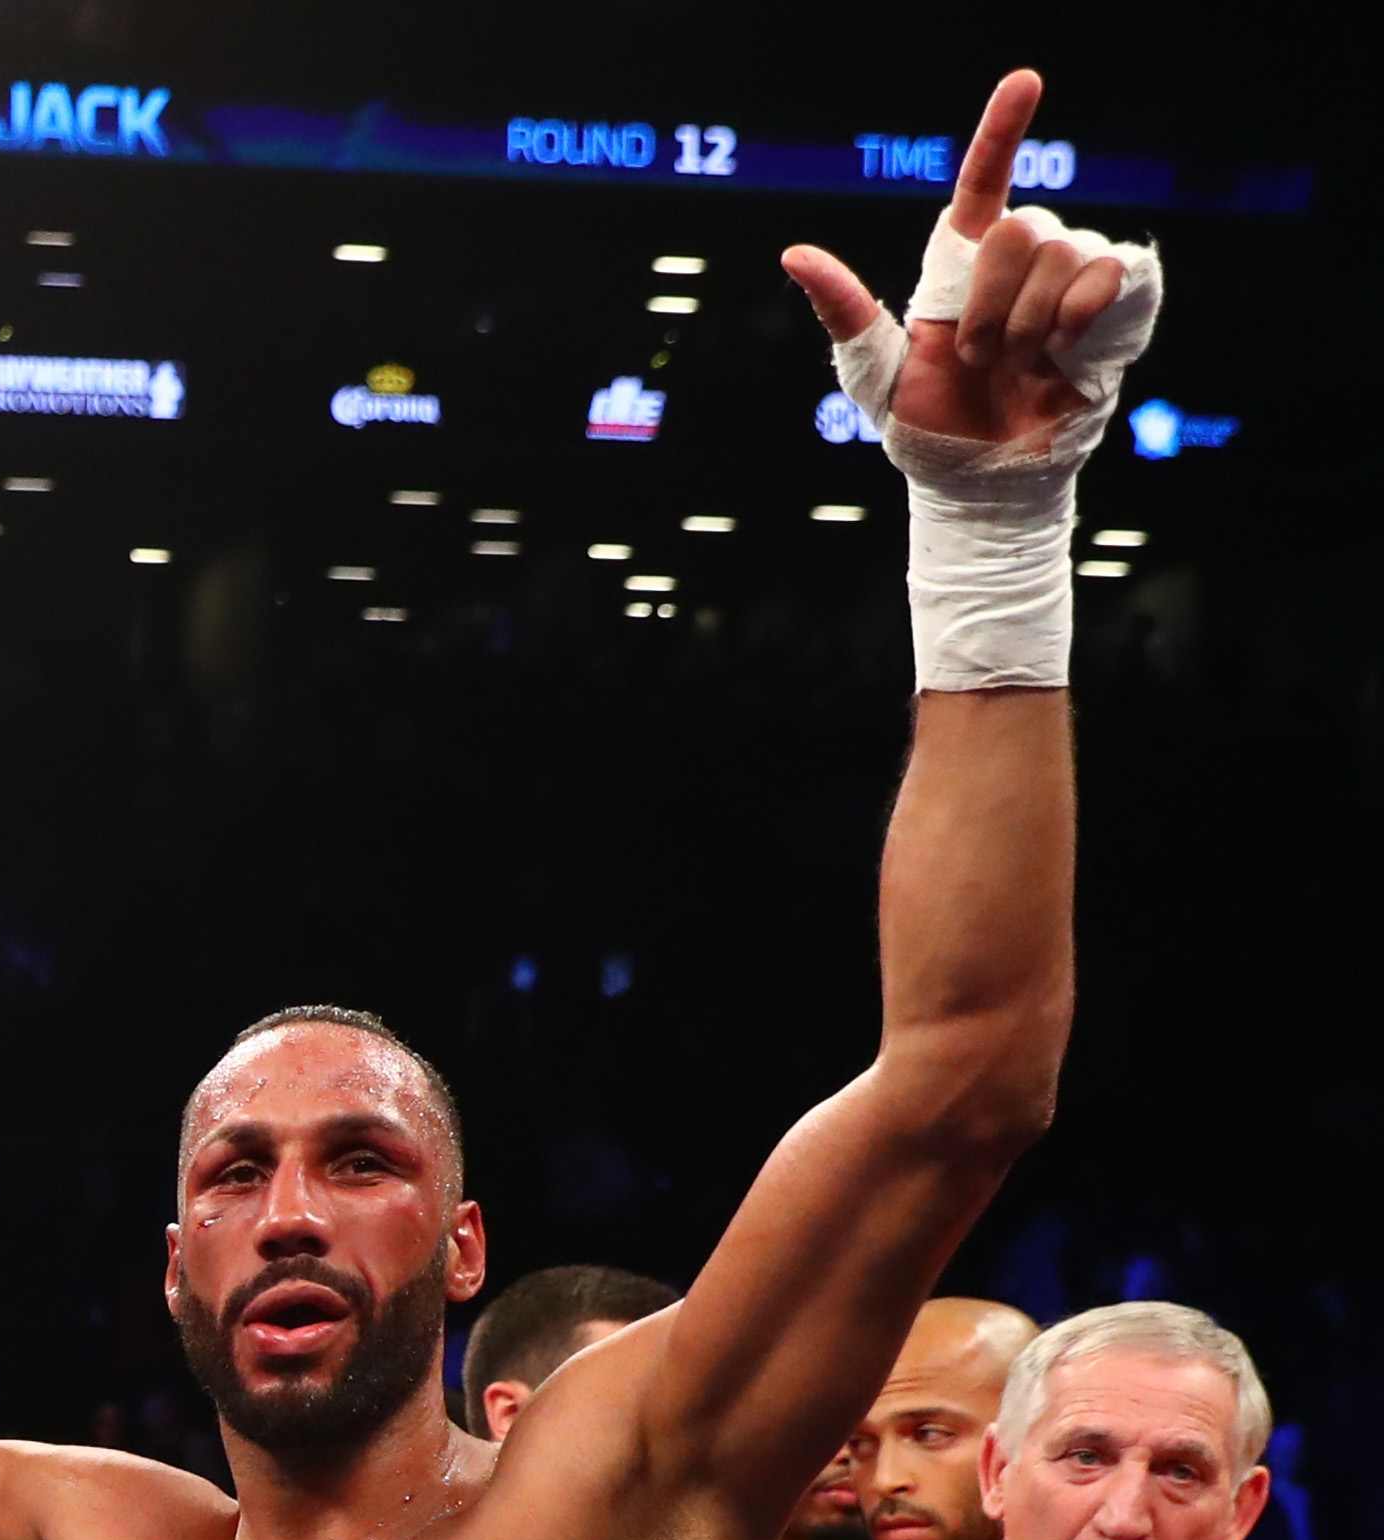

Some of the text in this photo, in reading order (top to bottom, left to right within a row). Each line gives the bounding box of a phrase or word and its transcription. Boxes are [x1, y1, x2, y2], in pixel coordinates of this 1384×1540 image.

[506, 118, 655, 169] ROUND
[674, 124, 737, 176] 12
[854, 133, 953, 183] TIME
